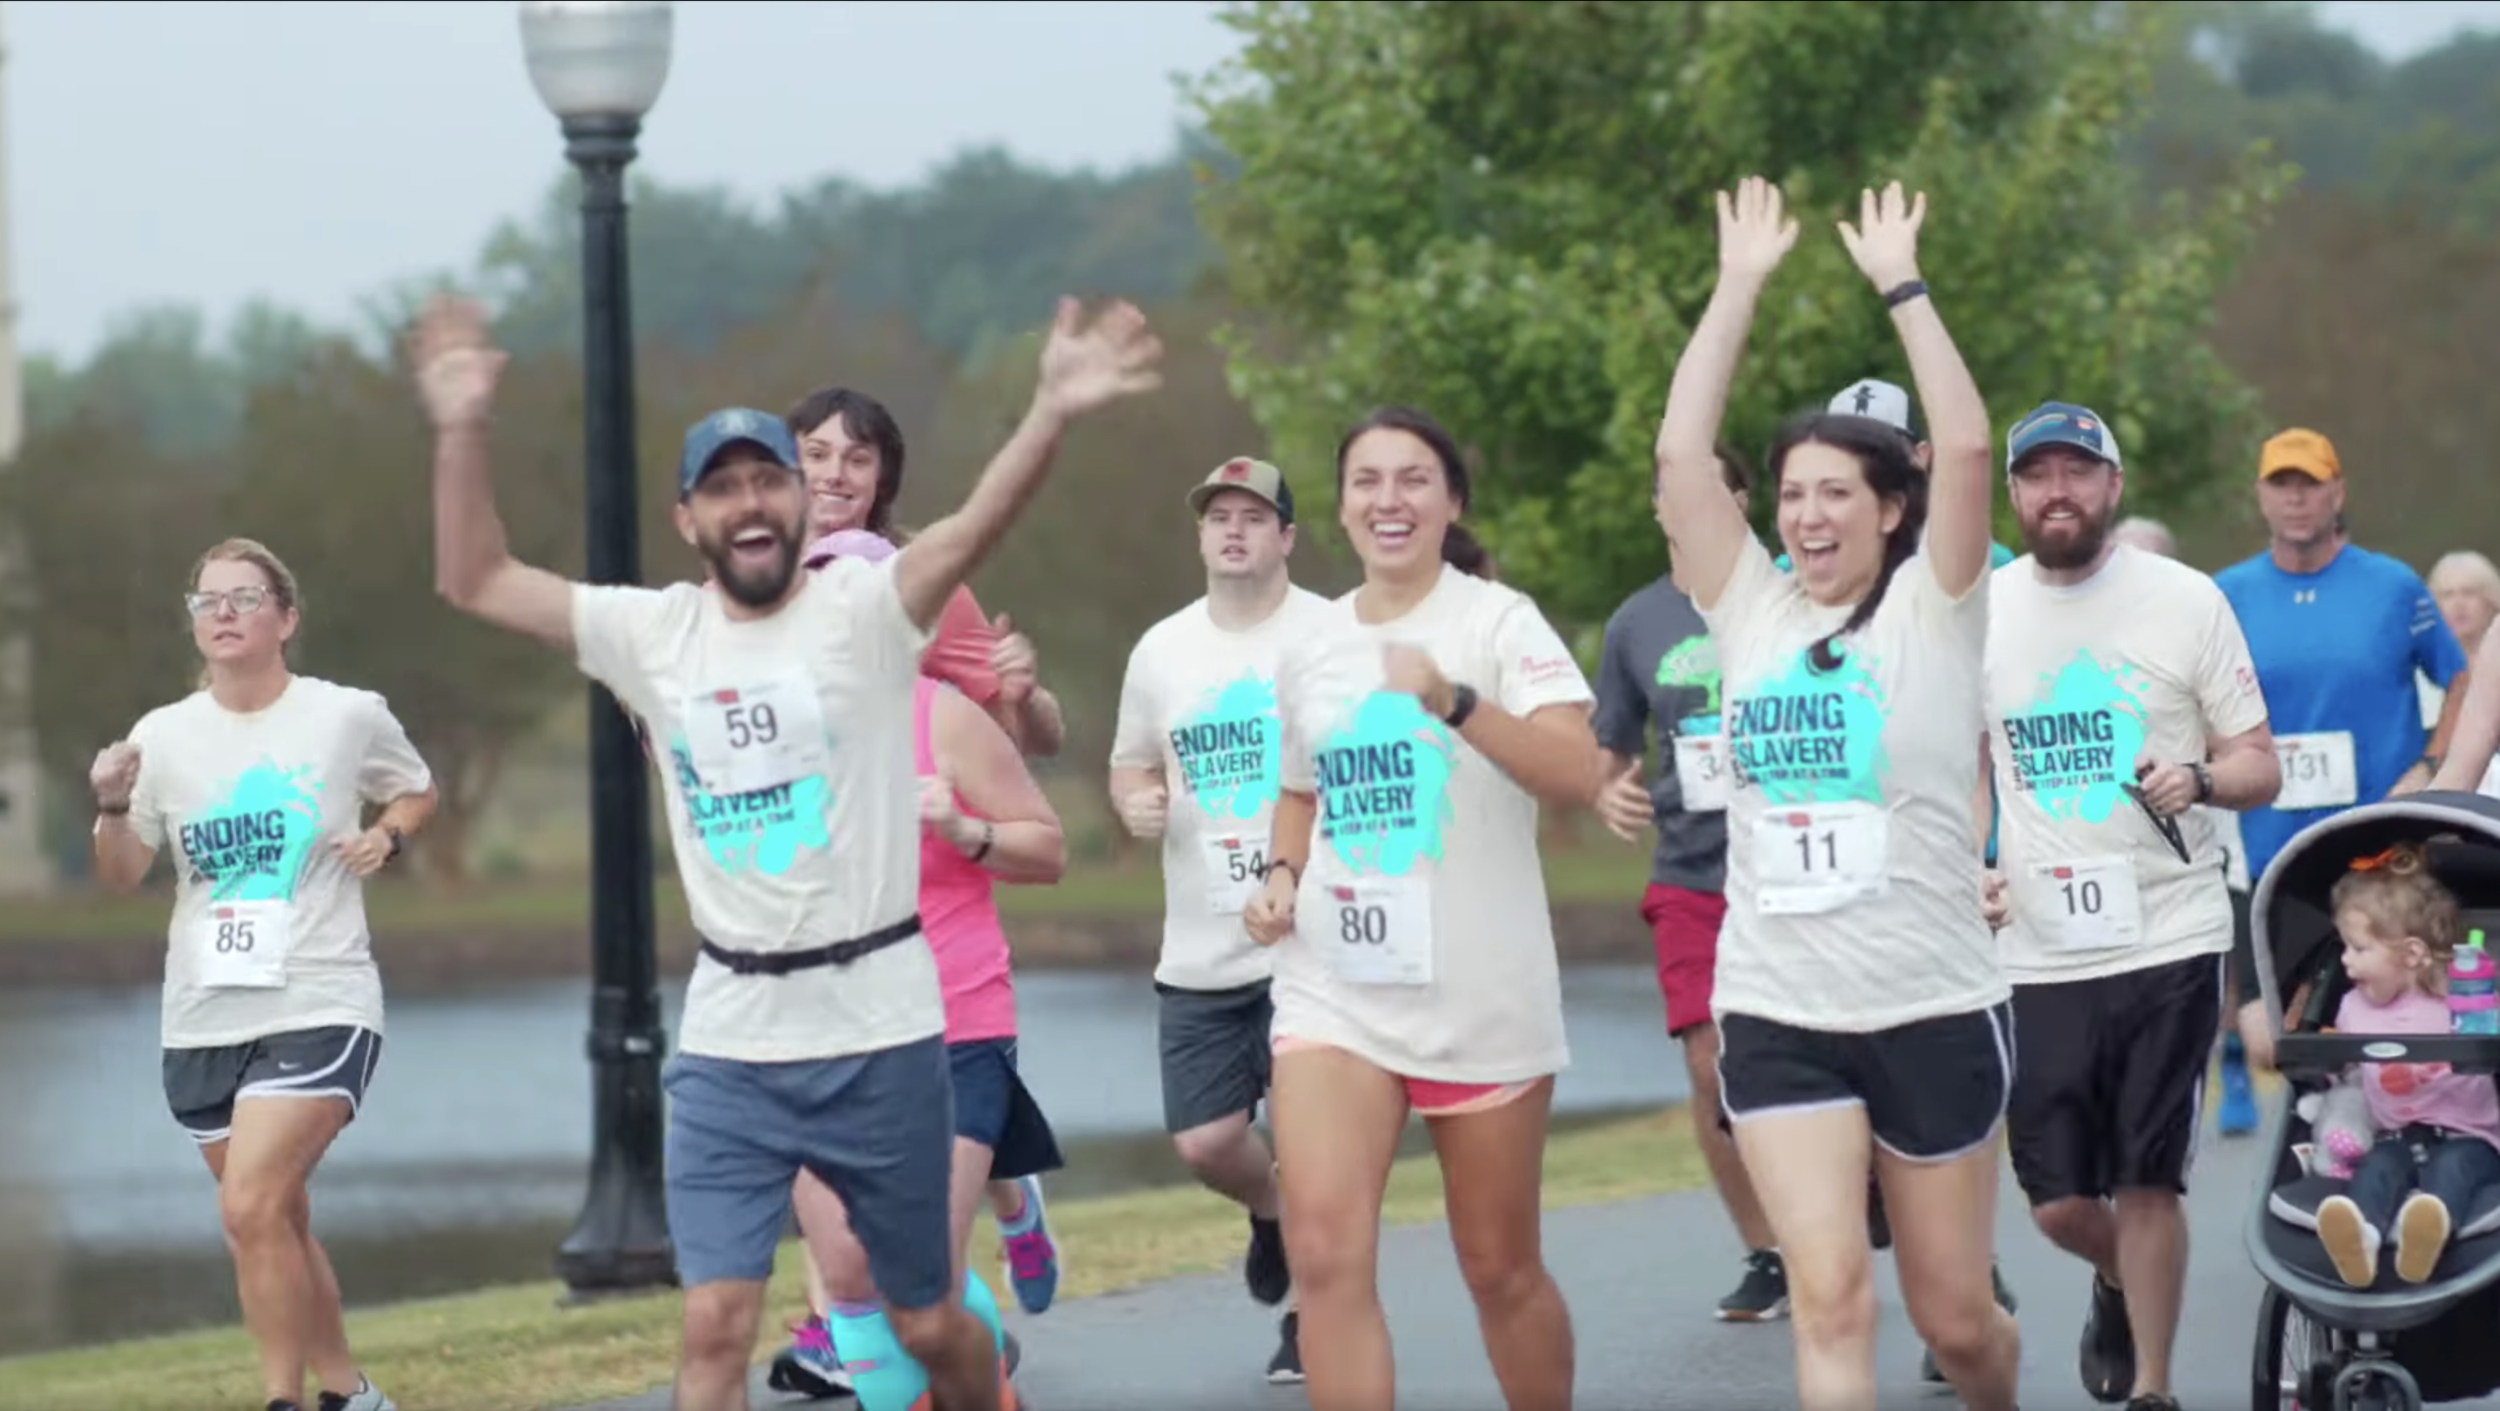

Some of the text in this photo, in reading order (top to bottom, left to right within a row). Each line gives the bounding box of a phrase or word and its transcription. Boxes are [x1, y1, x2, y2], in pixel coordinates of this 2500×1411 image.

[725, 703, 779, 749] 59
[1170, 717, 1264, 757] ENDING
[2003, 710, 2114, 751] ENDING
[1185, 750, 1264, 780] SLAVERY
[1736, 736, 1847, 769] SLAVERY
[2021, 746, 2115, 776] SLAVERY
[2284, 752, 2329, 781] 131
[179, 809, 286, 857] ENDING
[1795, 830, 1837, 872] 11
[1228, 850, 1265, 883] 54
[2061, 880, 2102, 916] 10
[216, 921, 255, 953] 85
[1340, 905, 1387, 945] 80
